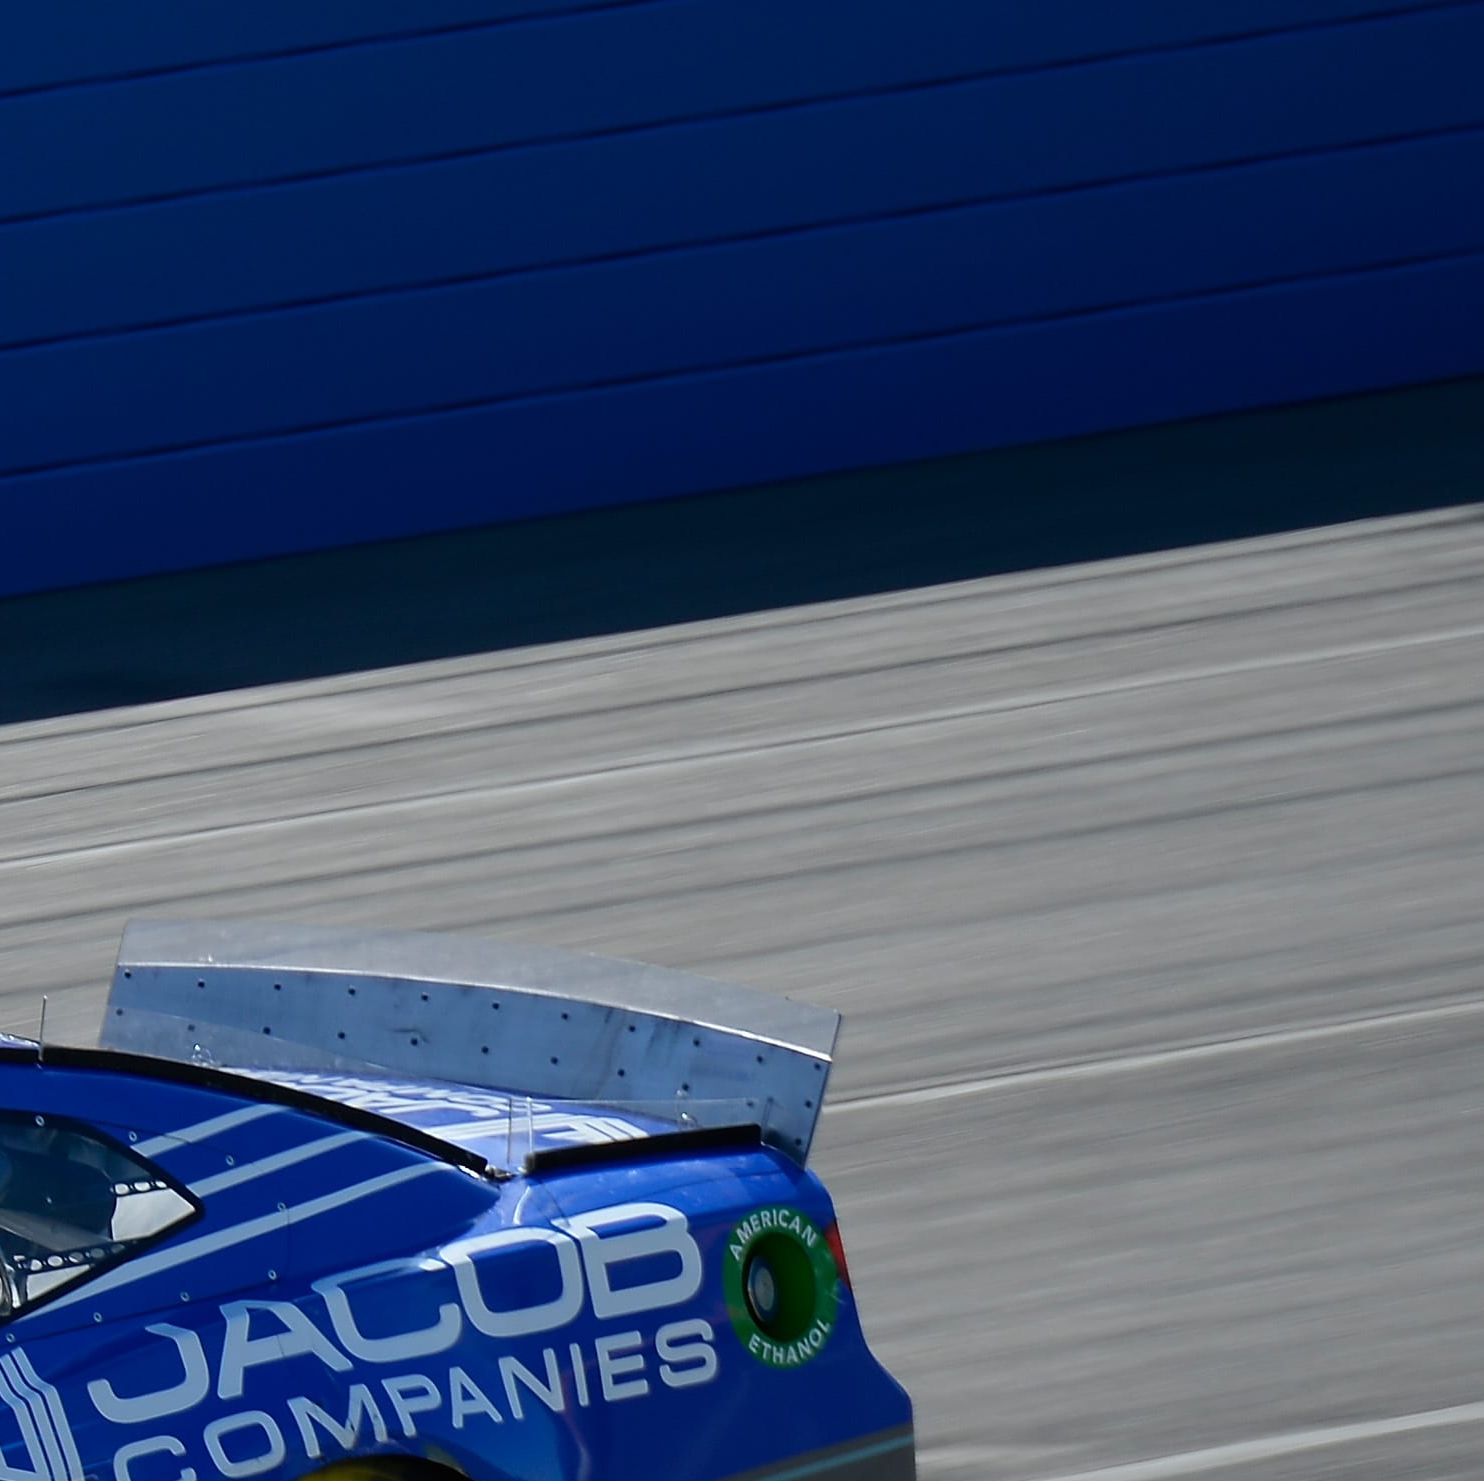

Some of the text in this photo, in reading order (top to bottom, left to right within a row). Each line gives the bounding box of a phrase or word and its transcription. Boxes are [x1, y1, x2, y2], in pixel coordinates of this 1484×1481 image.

[728, 1208, 818, 1261] AMERICAN
[86, 1200, 704, 1424] JACOB
[747, 1318, 832, 1365] ETHANOL
